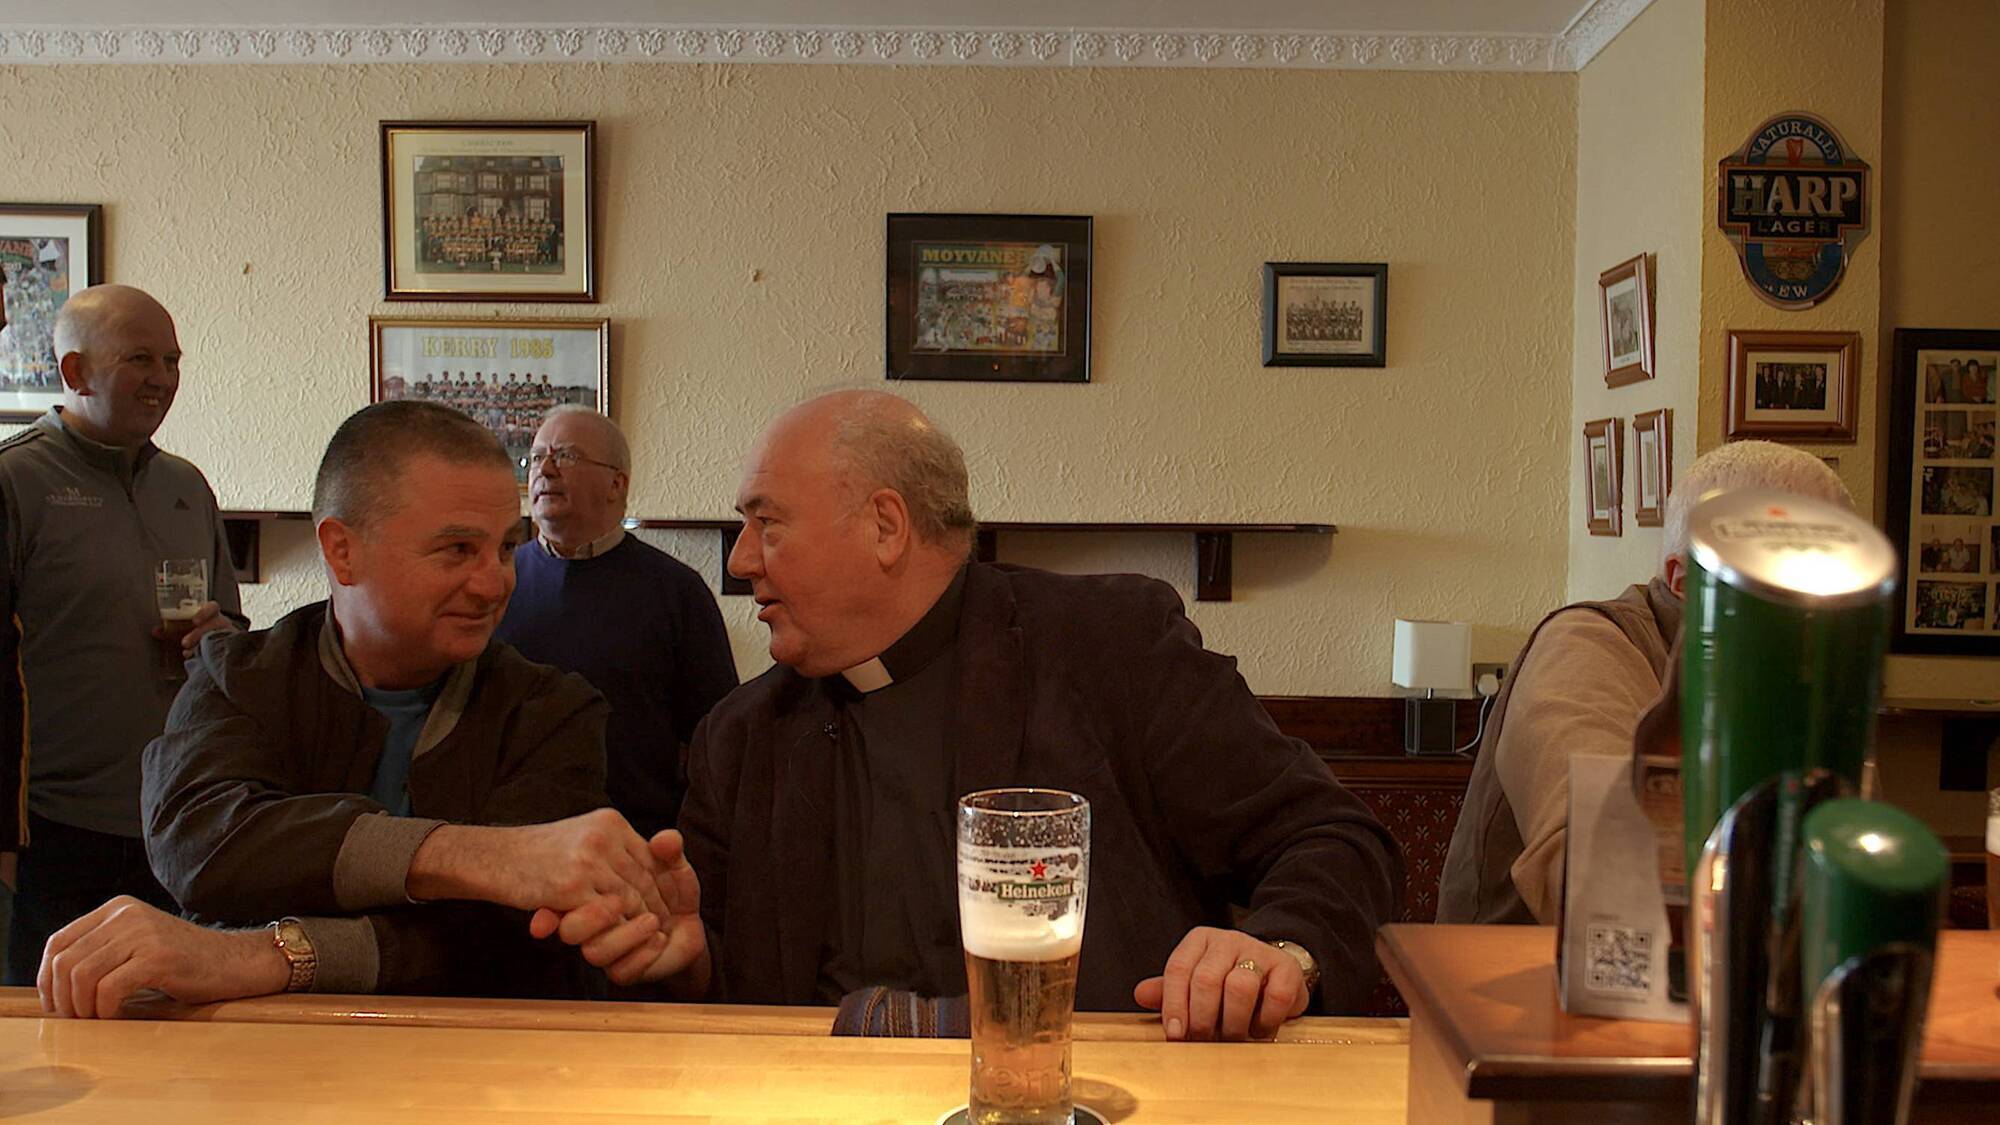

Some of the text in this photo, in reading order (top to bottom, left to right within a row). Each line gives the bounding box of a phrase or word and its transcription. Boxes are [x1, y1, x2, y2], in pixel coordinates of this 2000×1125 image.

[1732, 175, 1857, 217] HARP
[1759, 220, 1832, 233] LAGER
[421, 335, 555, 359] KERRY 1985
[1001, 882, 1072, 899] Heineken
